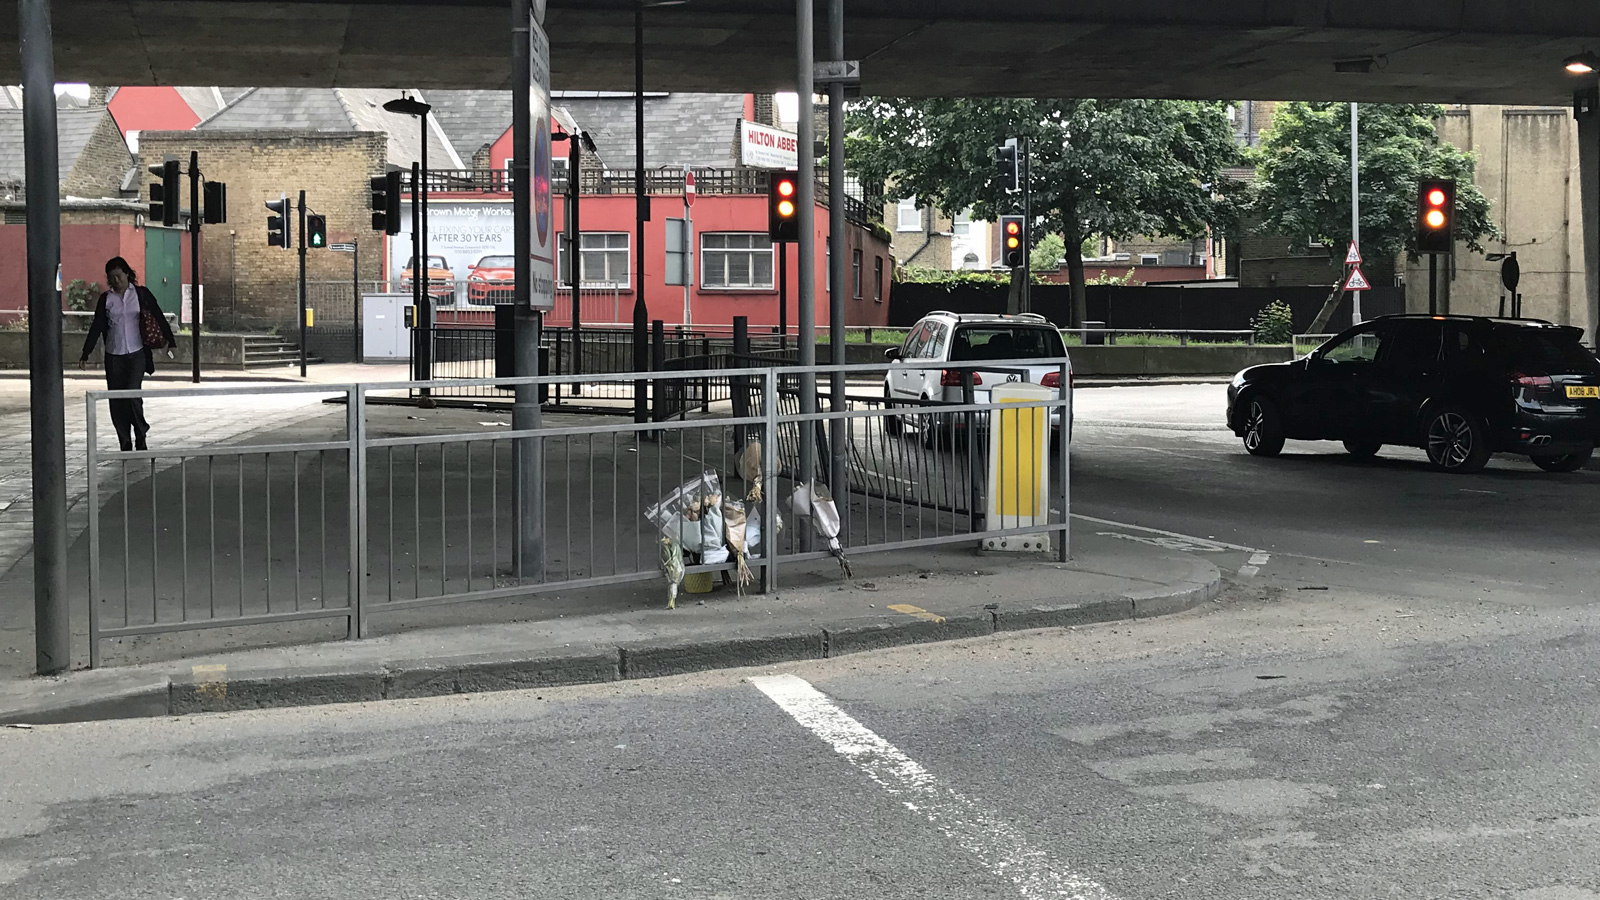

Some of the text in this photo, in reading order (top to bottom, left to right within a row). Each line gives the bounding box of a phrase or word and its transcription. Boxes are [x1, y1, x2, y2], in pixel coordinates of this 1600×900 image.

[748, 130, 775, 148] HILTON
[453, 207, 480, 216] Motor
[439, 226, 467, 234] FIXING
[468, 226, 493, 234] YOUR
[432, 234, 502, 242] AFTER 30 YEARS
